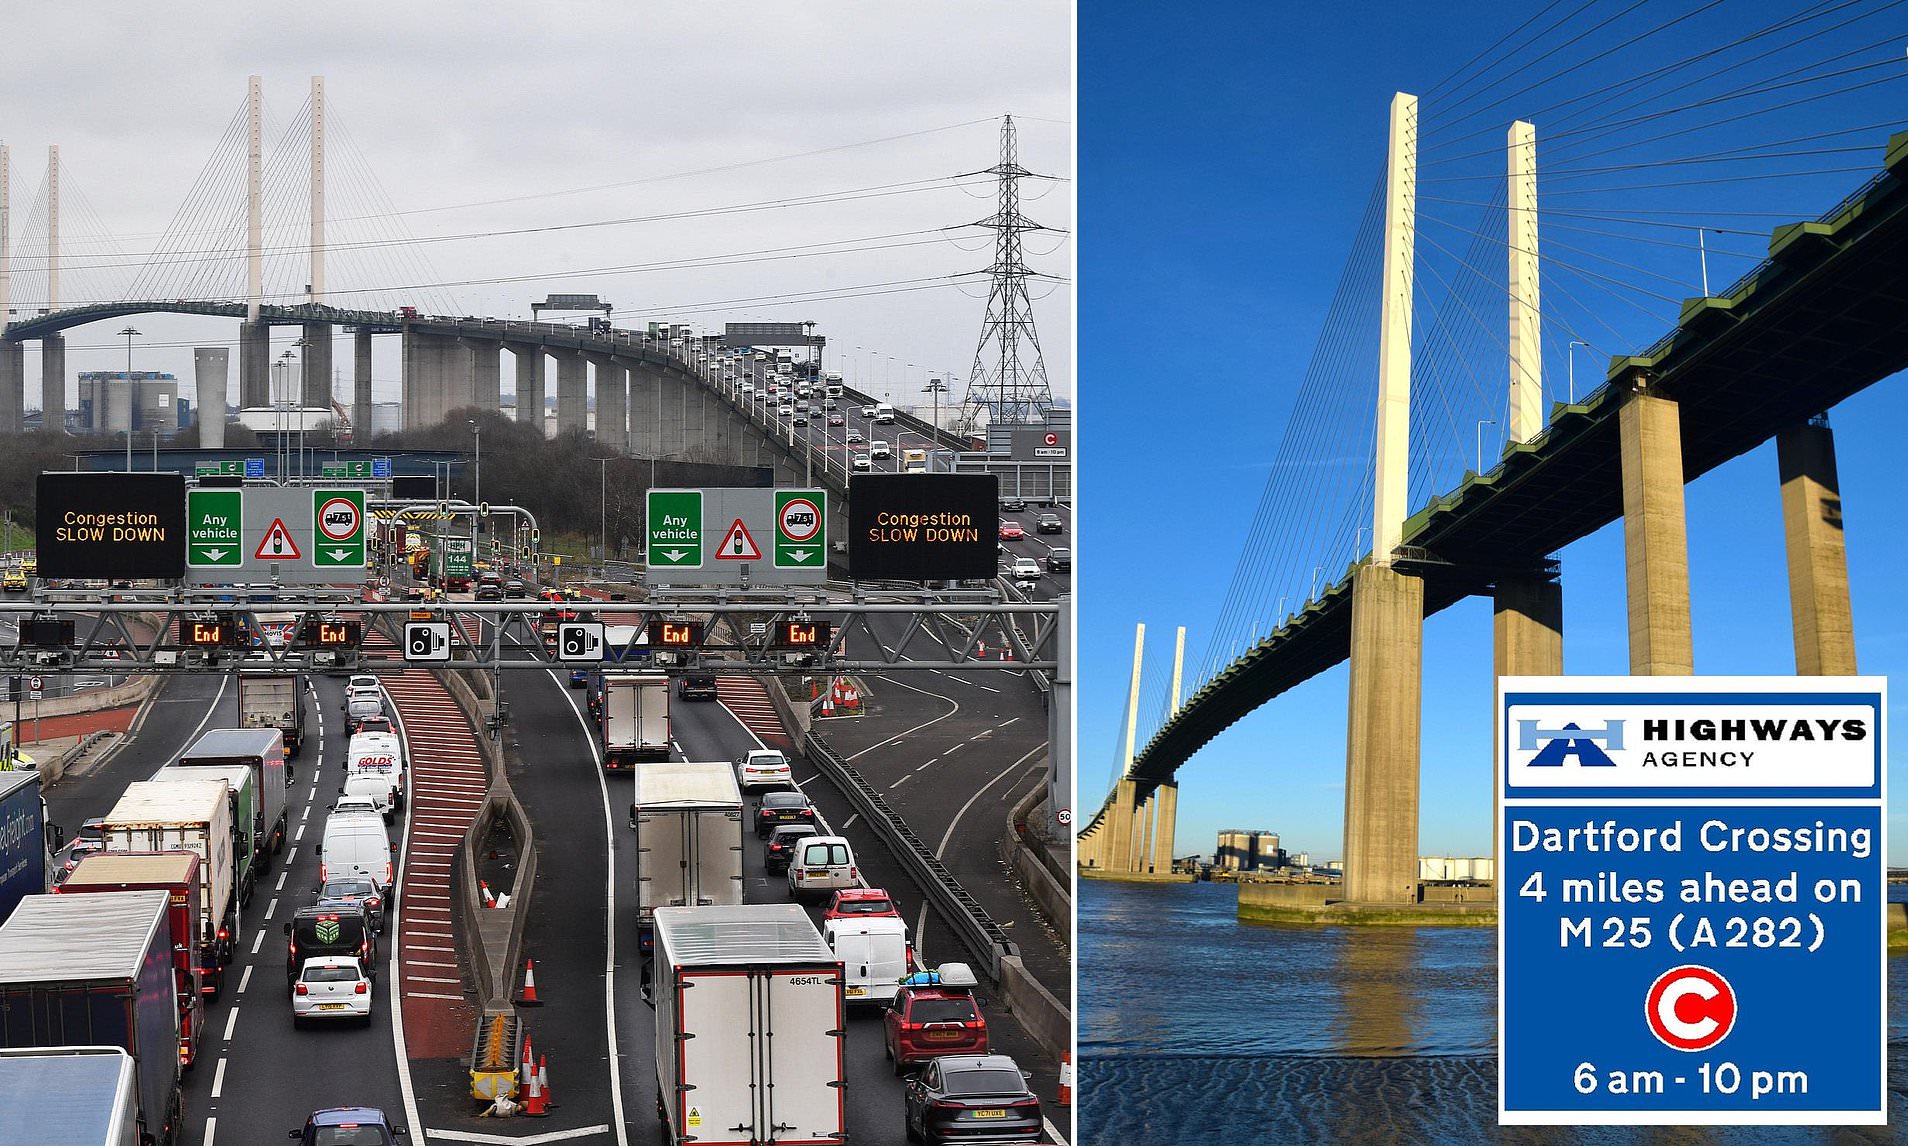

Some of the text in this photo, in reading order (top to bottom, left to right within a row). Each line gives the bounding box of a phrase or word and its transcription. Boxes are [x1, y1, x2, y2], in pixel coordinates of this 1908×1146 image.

[64, 511, 157, 527] Congestion
[202, 514, 227, 527] Any
[663, 514, 688, 528] Any
[877, 512, 971, 527] Congestion
[56, 528, 165, 542] SLOW DOWN
[192, 527, 238, 539] vehicle
[652, 528, 698, 539] vehicle
[869, 528, 978, 542] SLOW DOWN
[194, 624, 219, 642] End
[321, 624, 346, 642] End
[663, 624, 689, 643] End
[789, 624, 815, 643] End
[358, 757, 393, 766] GOLDS
[1060, 813, 1070, 821] 50
[789, 976, 822, 986] 4654TL
